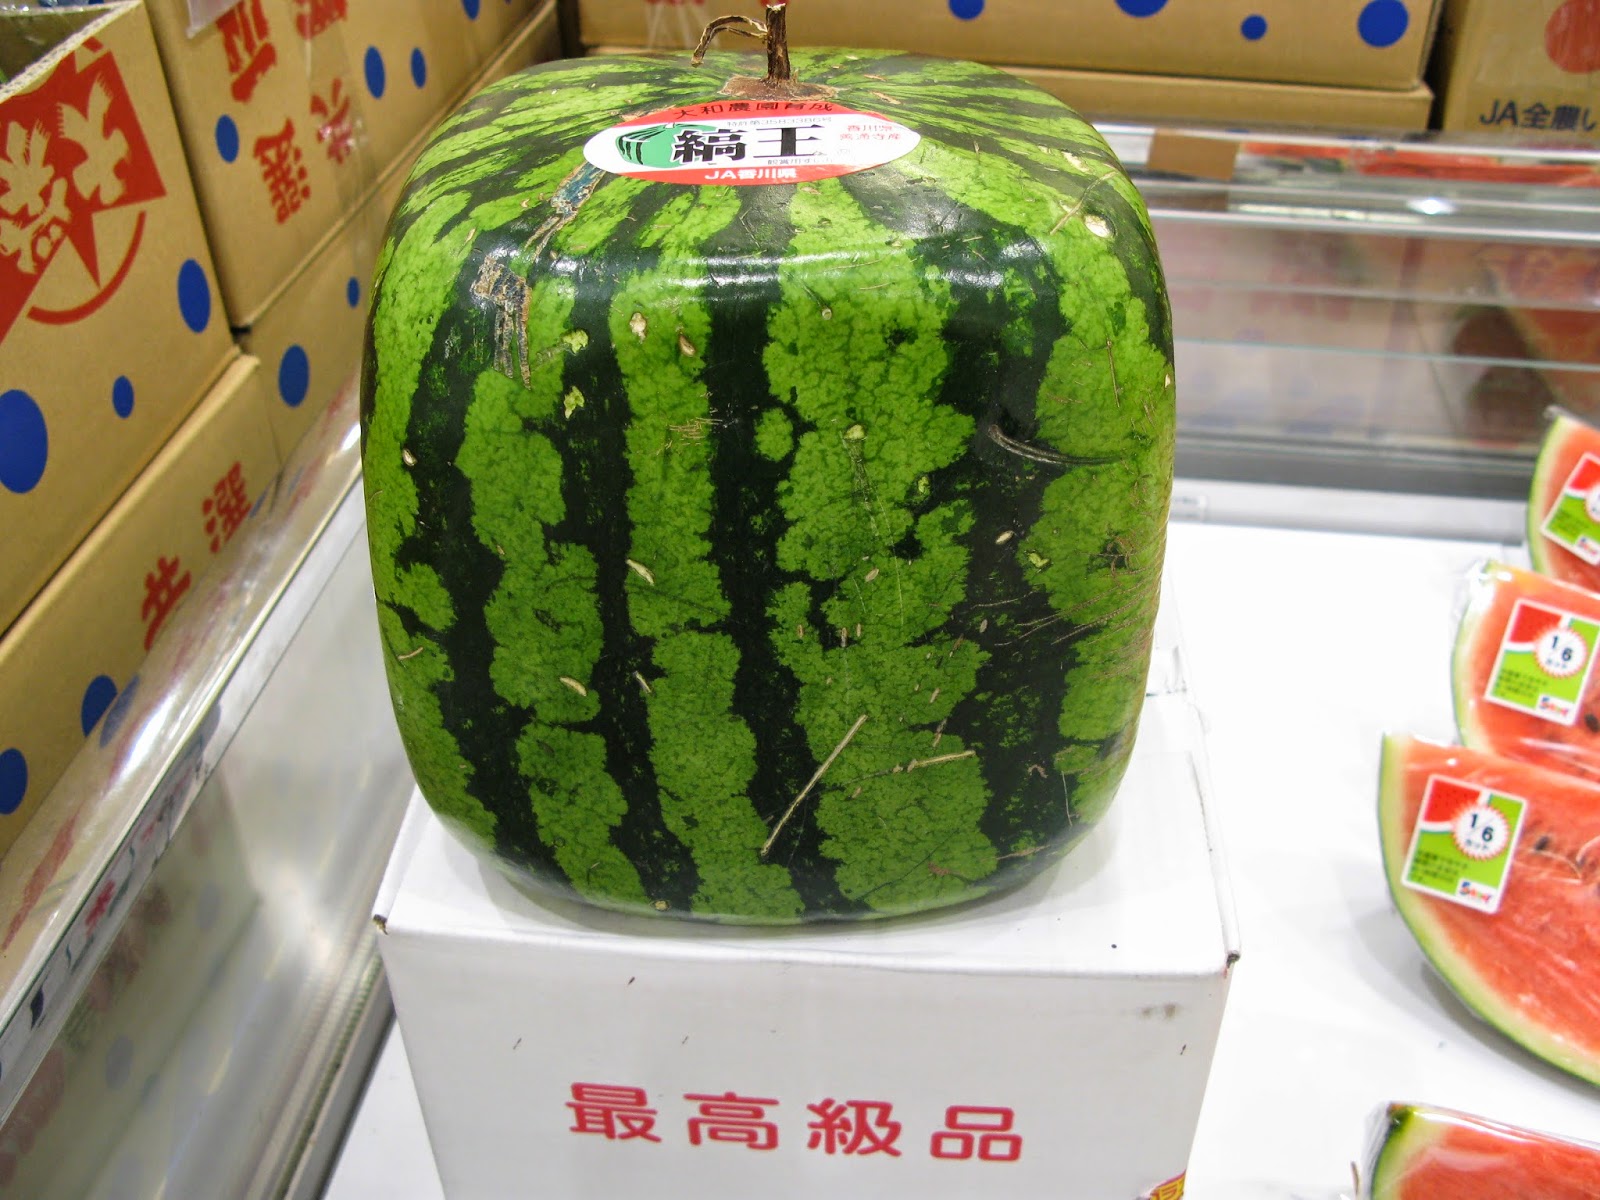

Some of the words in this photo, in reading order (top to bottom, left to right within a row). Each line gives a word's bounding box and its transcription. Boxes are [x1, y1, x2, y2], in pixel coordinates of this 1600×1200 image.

[673, 124, 825, 164] 縞王
[704, 168, 798, 180] JA香川県
[565, 1082, 1024, 1163] 最高級品
